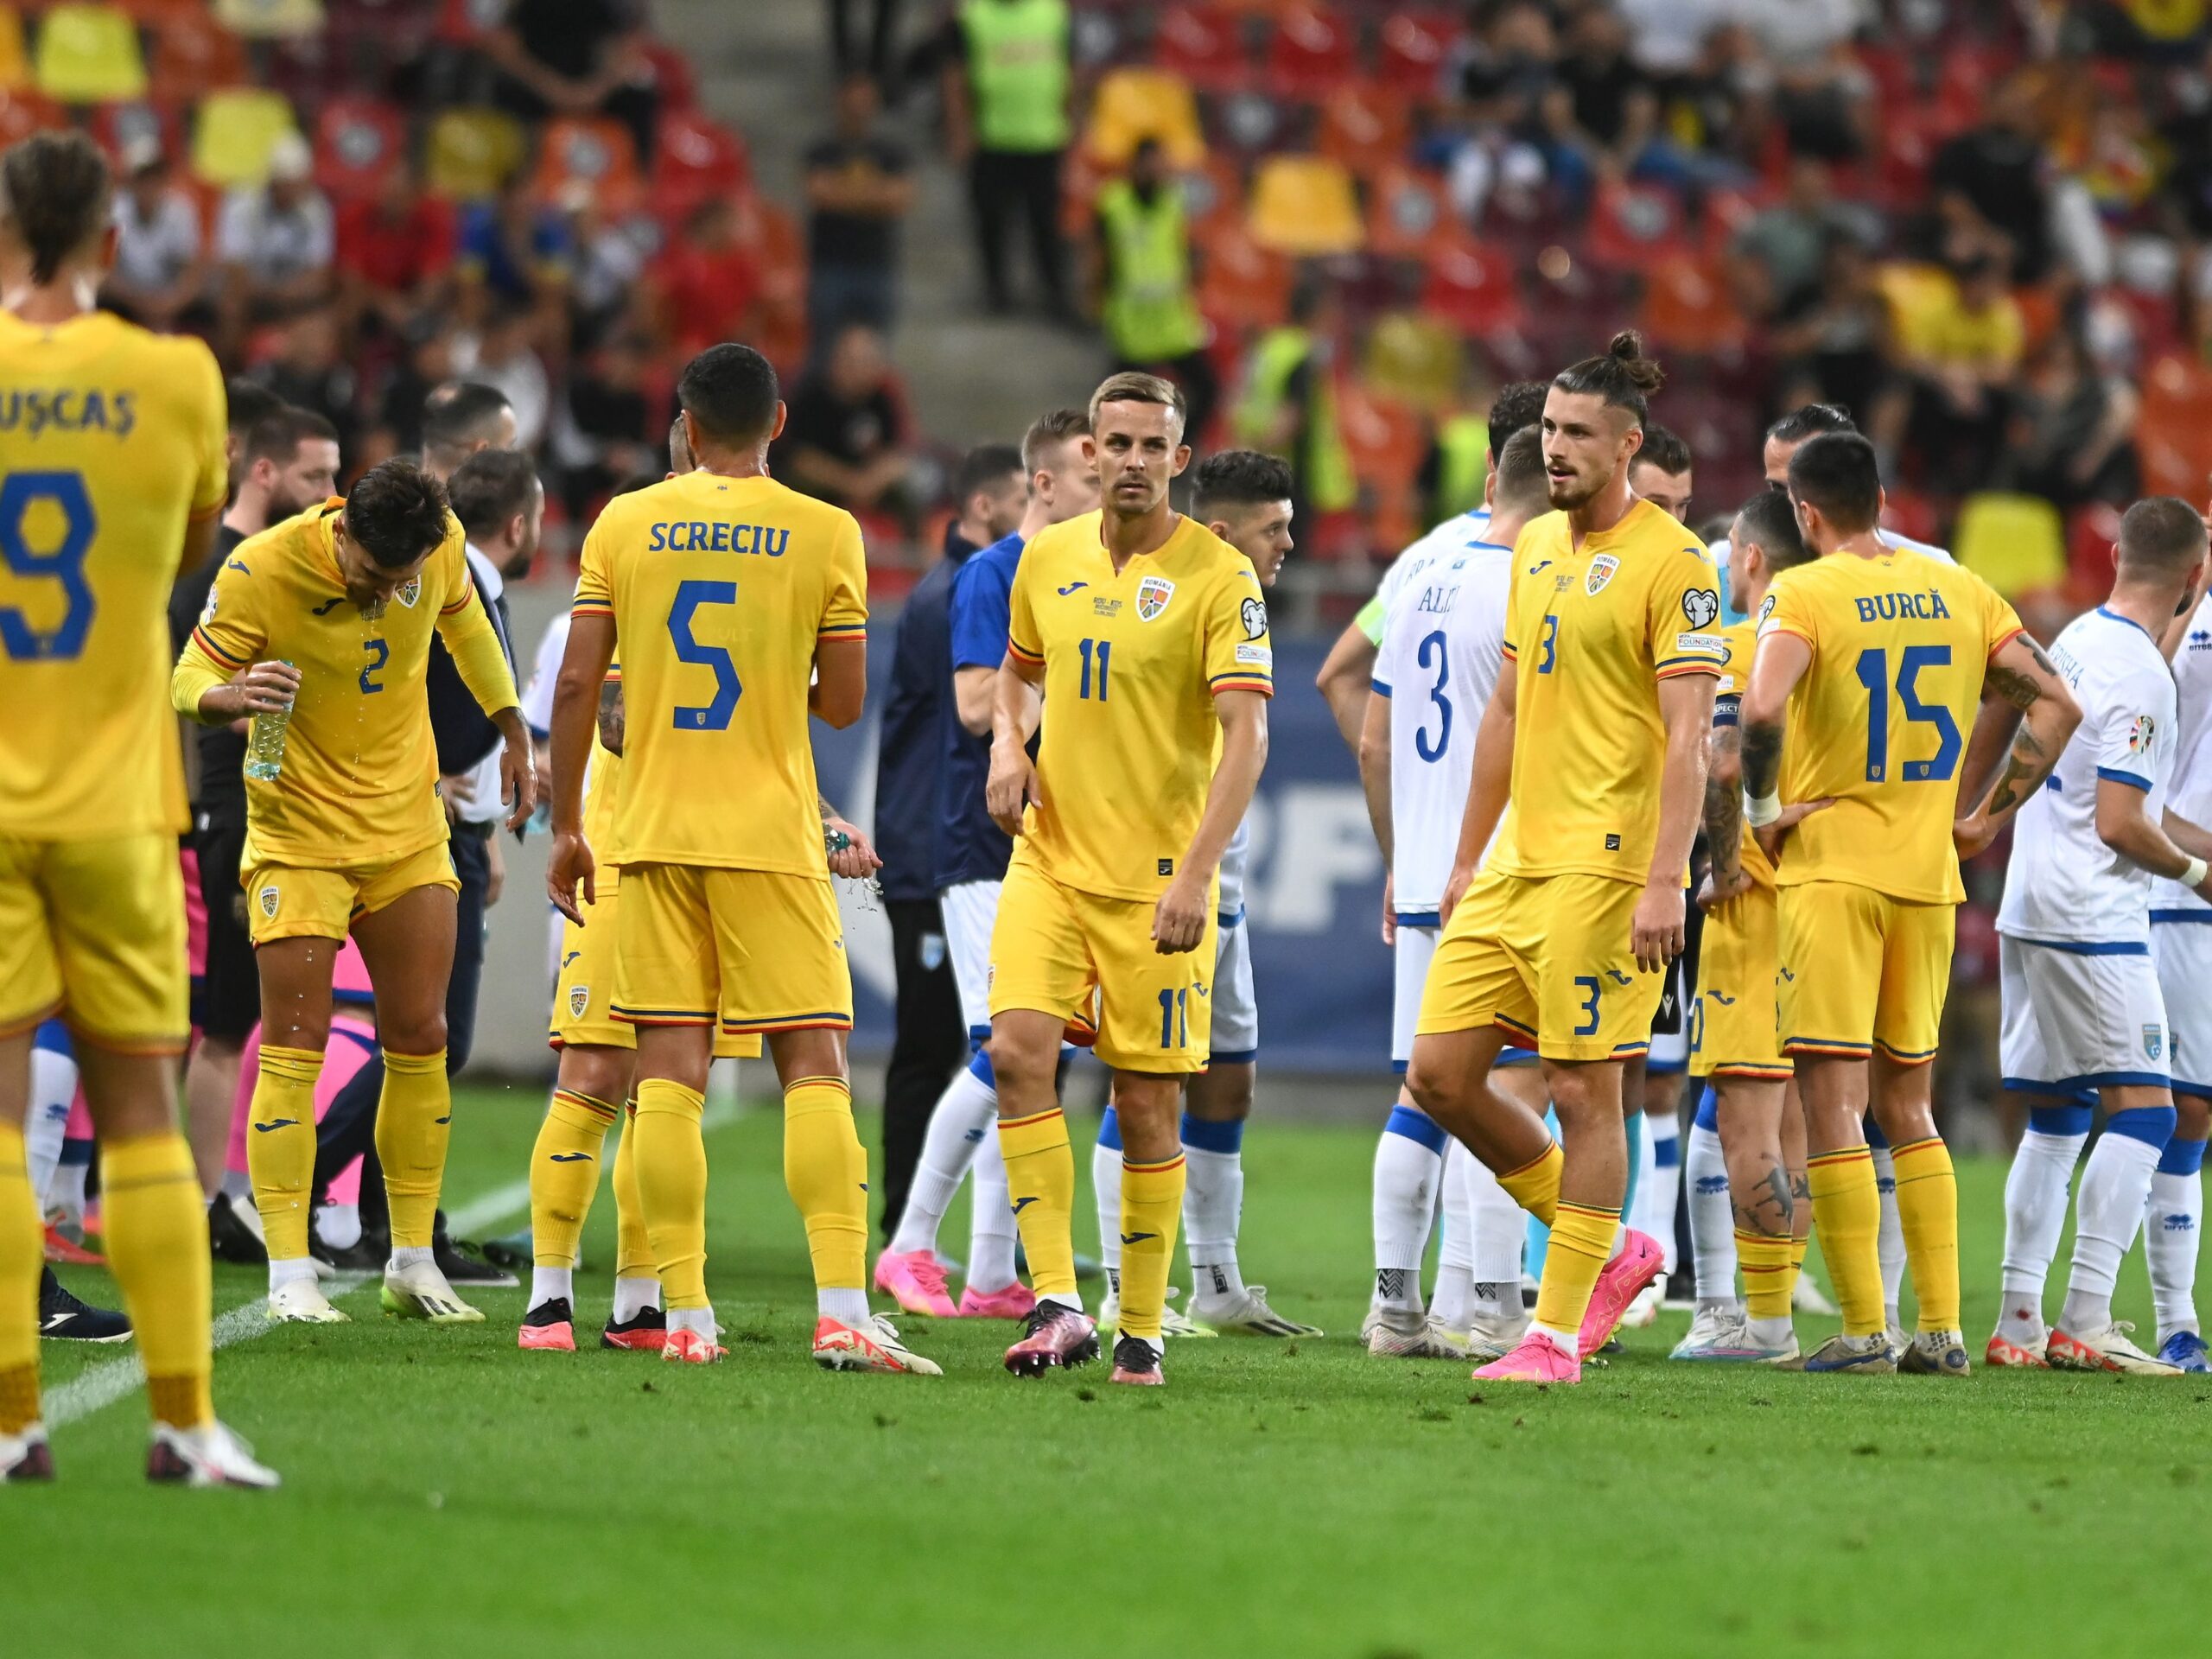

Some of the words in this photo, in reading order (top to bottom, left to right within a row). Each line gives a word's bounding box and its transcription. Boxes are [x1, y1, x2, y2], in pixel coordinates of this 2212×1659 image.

[0, 471, 96, 662] 9
[649, 522, 790, 557] SCRECIU
[1854, 588, 1951, 623] BURCĂ
[359, 639, 390, 695] 2
[667, 580, 743, 731] 5
[1078, 638, 1111, 702] 11
[1537, 614, 1559, 674] 3
[1415, 630, 1453, 763] 3
[1855, 645, 1963, 783] 15
[1158, 988, 1186, 1048] 11
[1574, 976, 1601, 1035] 3
